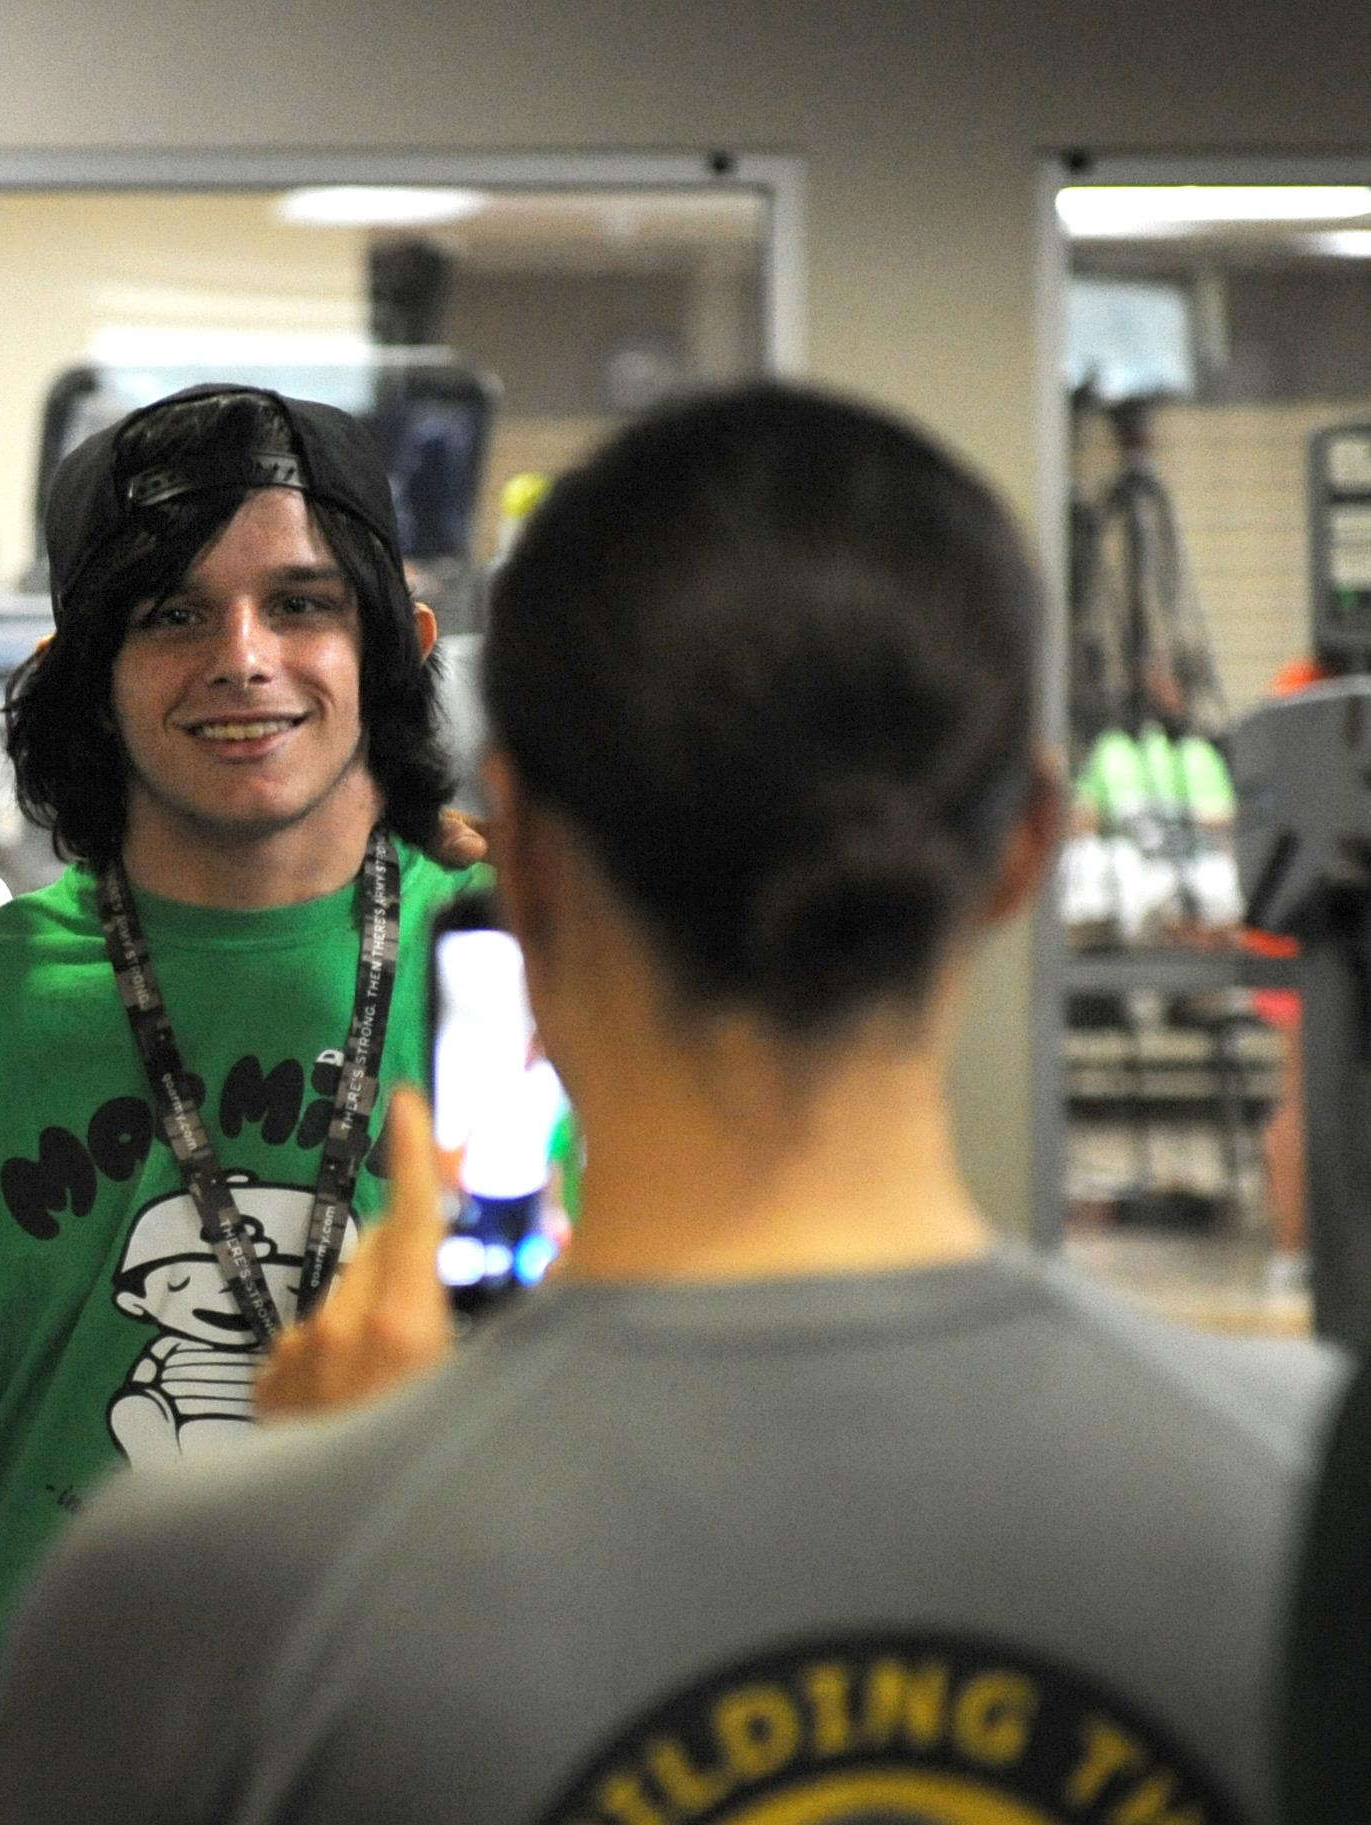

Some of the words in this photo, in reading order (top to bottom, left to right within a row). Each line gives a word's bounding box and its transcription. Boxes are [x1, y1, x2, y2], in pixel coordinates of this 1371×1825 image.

[341, 1069, 365, 1130] THERE'S
[367, 961, 382, 997] THEN
[375, 876, 388, 906] ARMY
[161, 1072, 198, 1151] goarmy.com
[219, 1218, 252, 1280] THERE'S
[310, 1205, 336, 1288] goarmy.com
